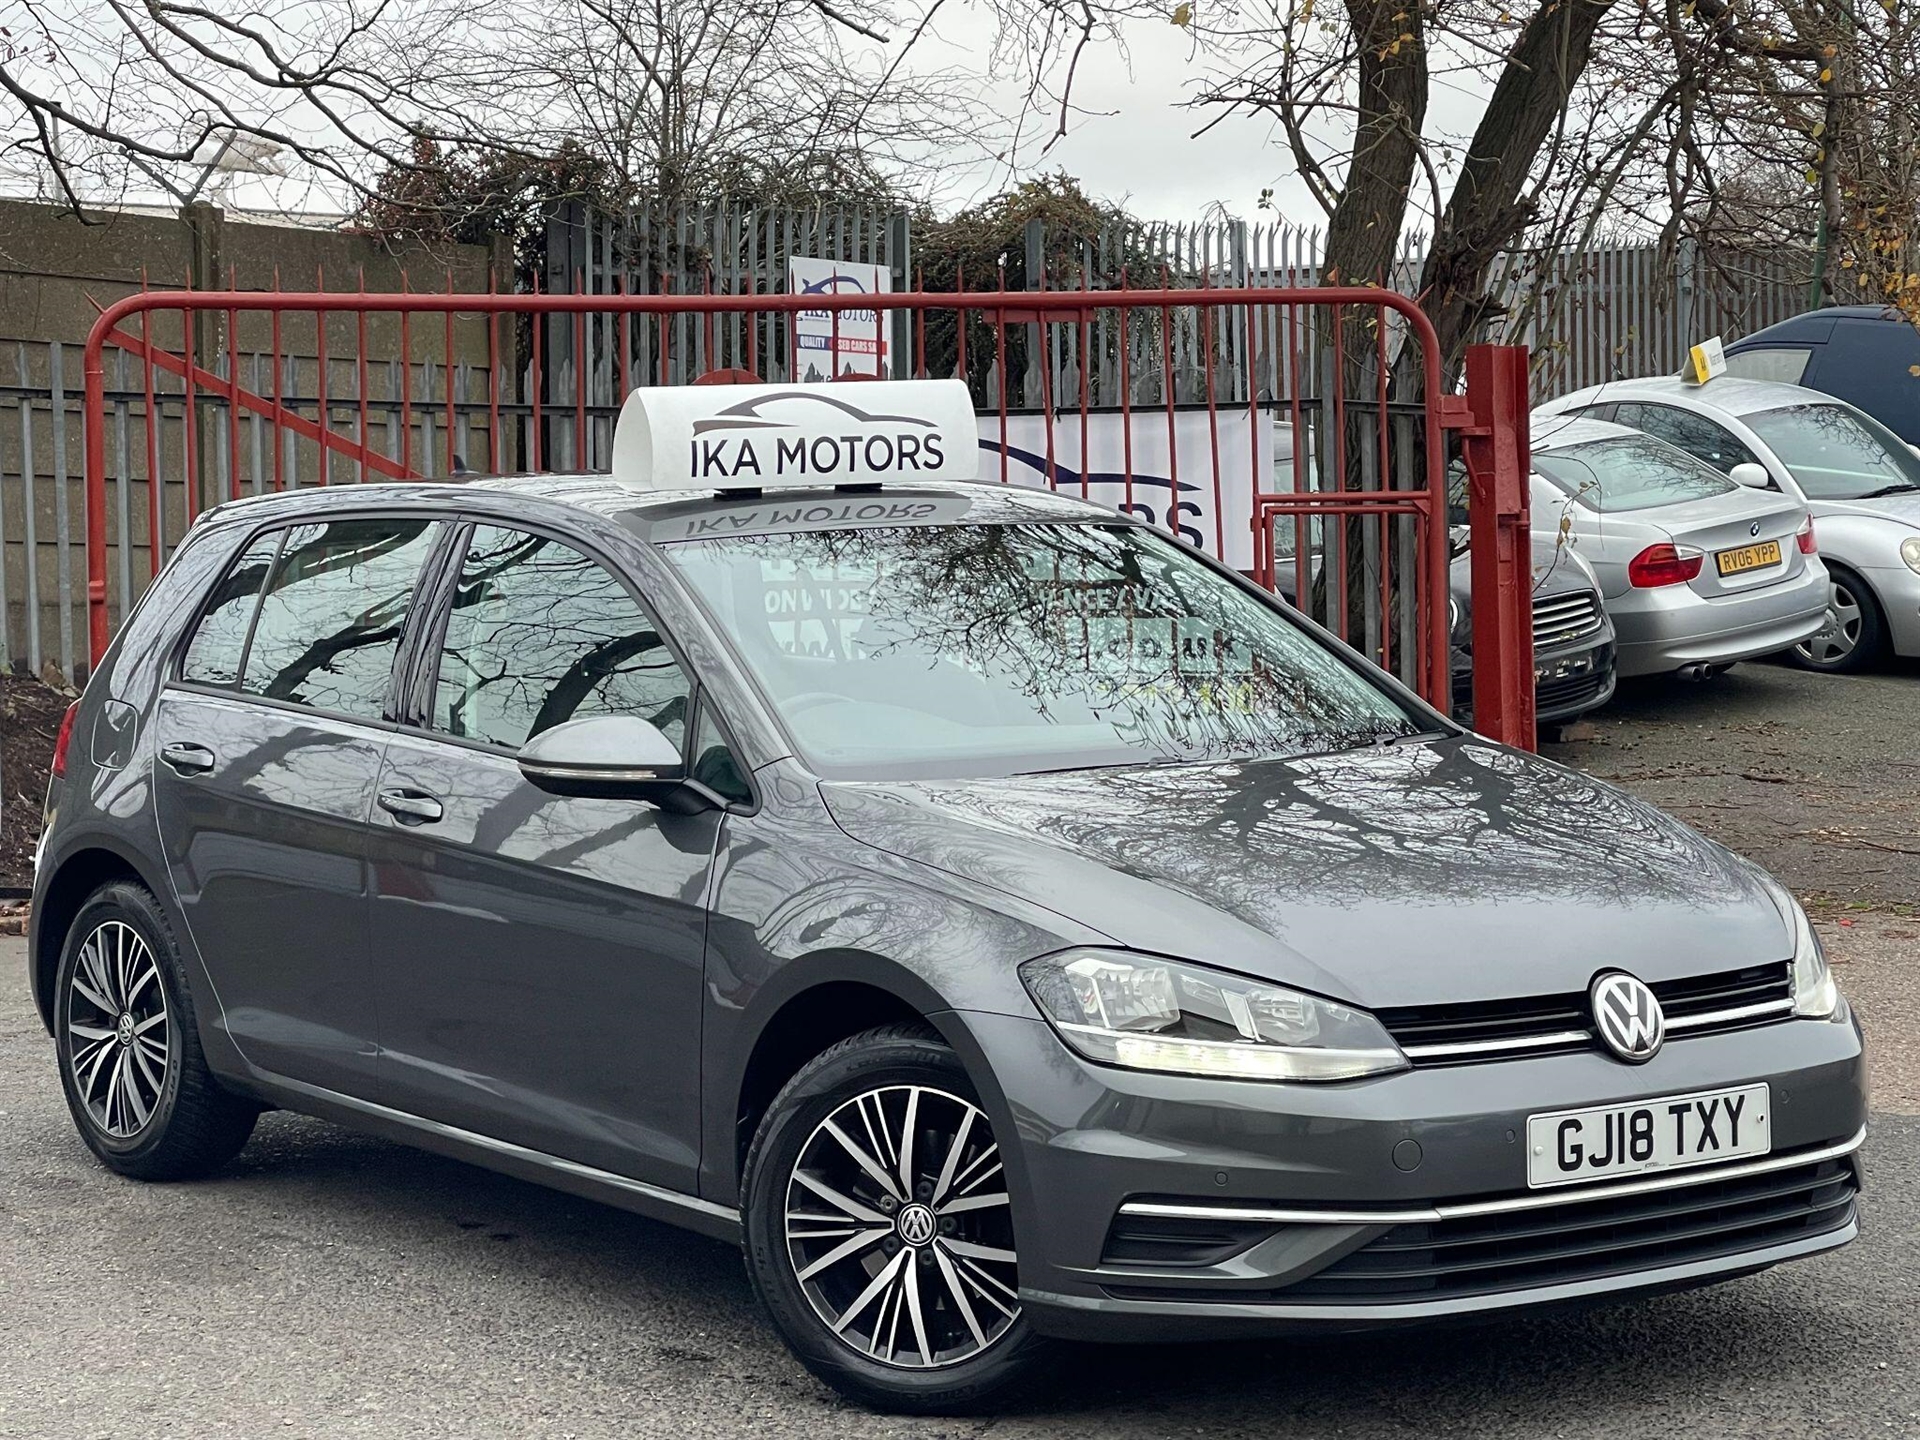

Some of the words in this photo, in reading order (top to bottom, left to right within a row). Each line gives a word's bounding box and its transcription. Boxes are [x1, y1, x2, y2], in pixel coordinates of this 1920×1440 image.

[800, 335, 825, 348] QUALITY
[851, 340, 867, 352] CARS
[691, 438, 762, 478] IKA
[777, 433, 944, 475] MOTORS
[1723, 550, 1753, 570] RV06
[1754, 544, 1775, 563] YPP
[1557, 1109, 1654, 1172] GJ18
[1668, 1094, 1746, 1156] TXY
